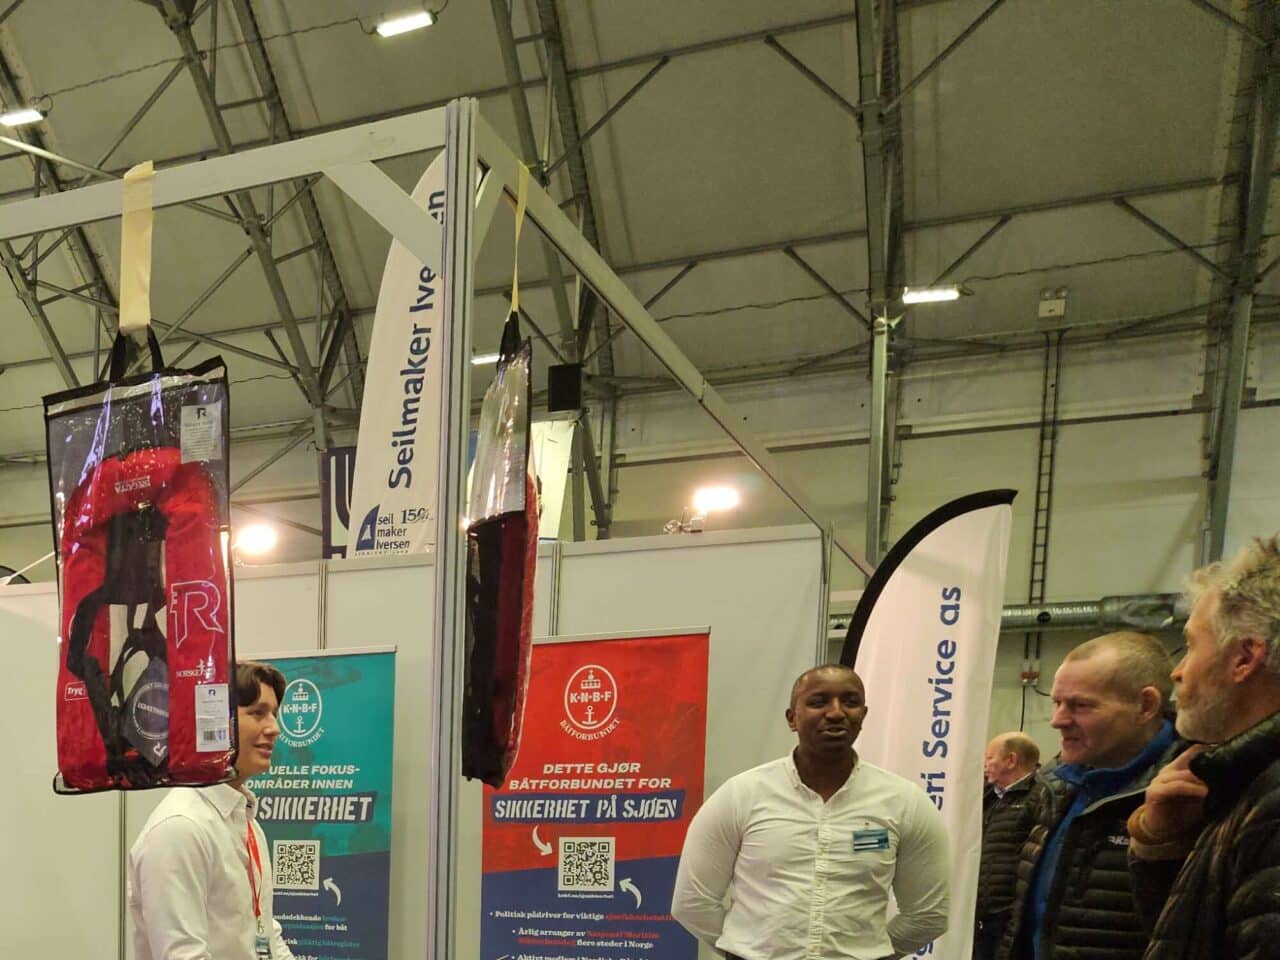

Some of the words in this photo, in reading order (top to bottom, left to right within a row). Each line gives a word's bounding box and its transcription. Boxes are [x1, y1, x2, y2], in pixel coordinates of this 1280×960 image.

[388, 323, 432, 489] Seilmaker
[377, 512, 394, 526] seil
[377, 525, 407, 537] maker
[376, 539, 410, 550] Iversen
[923, 639, 957, 758] Service
[940, 586, 962, 626] as
[311, 765, 361, 775] FOKUS-
[543, 763, 594, 774] DETTE
[597, 762, 641, 774] GJØR
[246, 778, 309, 789] OMRÅDER
[312, 779, 354, 789] INNEN
[509, 777, 636, 790] BÅTFORBUNDET
[638, 778, 672, 789] FOR
[255, 796, 373, 821] SIKKERHET
[494, 799, 590, 819] SIKKERHET
[596, 794, 617, 819] PÅ
[622, 798, 677, 820] SJØEN
